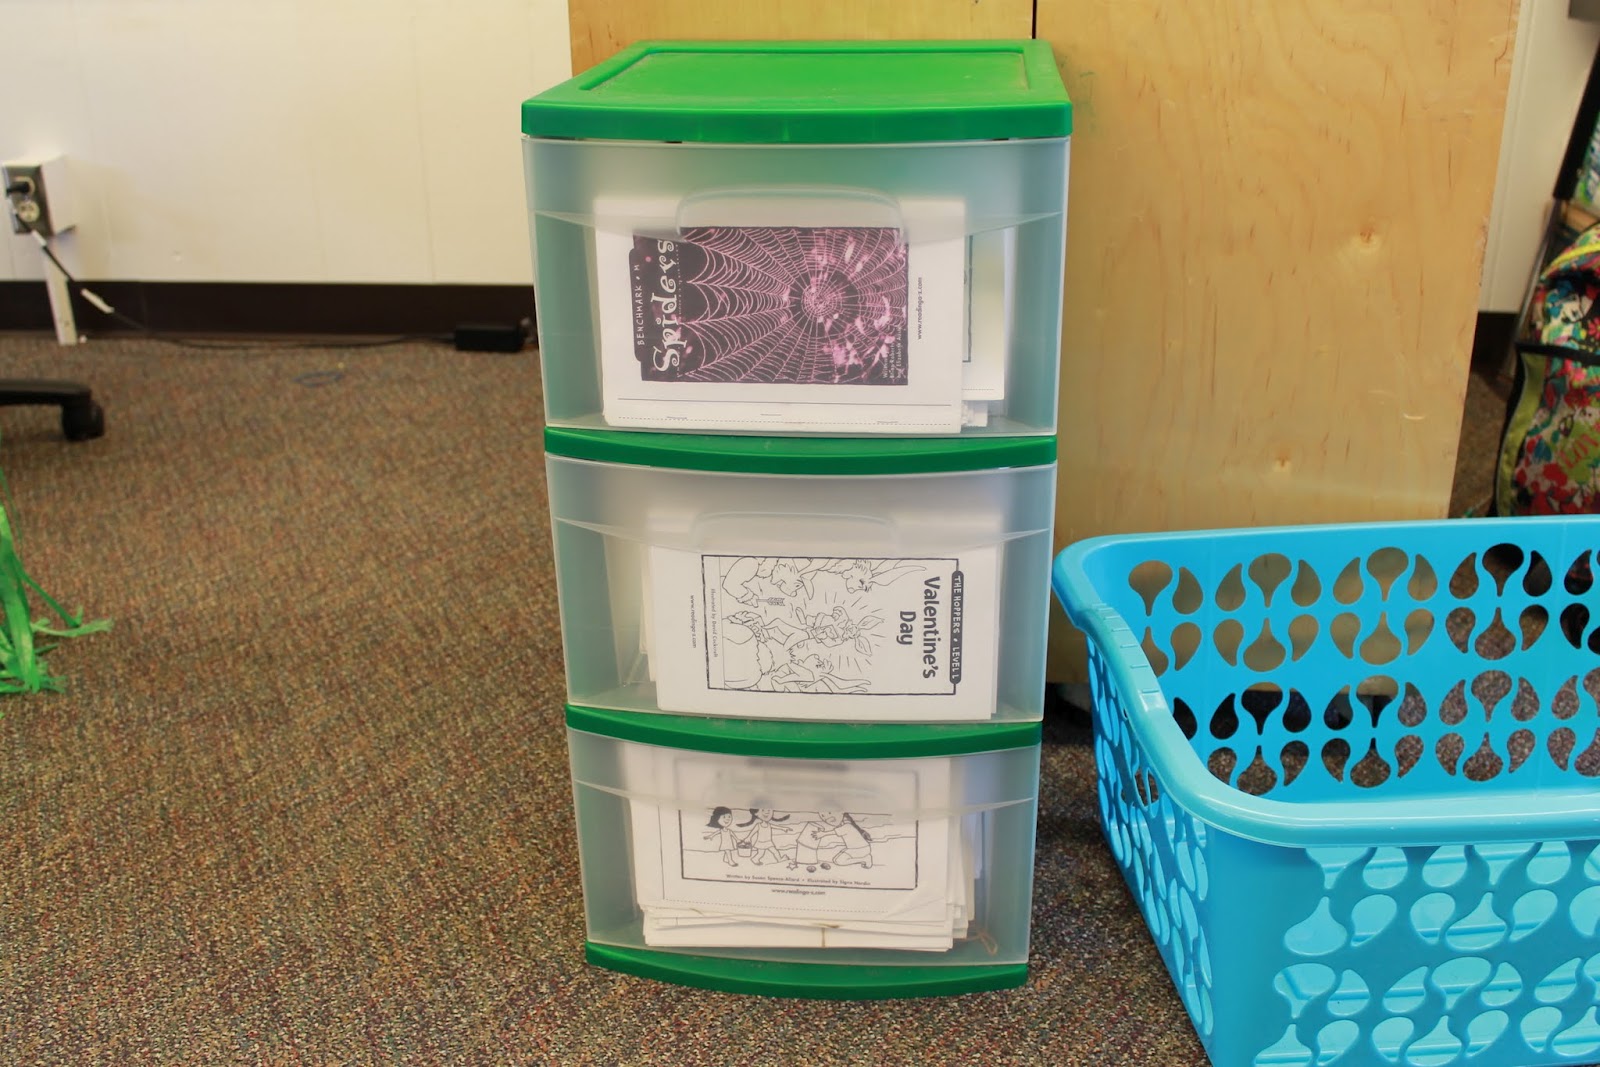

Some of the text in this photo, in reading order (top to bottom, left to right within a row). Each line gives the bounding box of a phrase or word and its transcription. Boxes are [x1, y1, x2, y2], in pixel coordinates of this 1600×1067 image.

[634, 285, 646, 346] BENCHMARK
[650, 239, 687, 372] Spiders
[915, 276, 924, 340] www.readinga-z.com
[953, 575, 962, 593] THE
[896, 610, 917, 645] Day
[922, 576, 941, 679] Valentine's
[952, 595, 961, 634] HOPPERS
[951, 646, 960, 672] LEVEL
